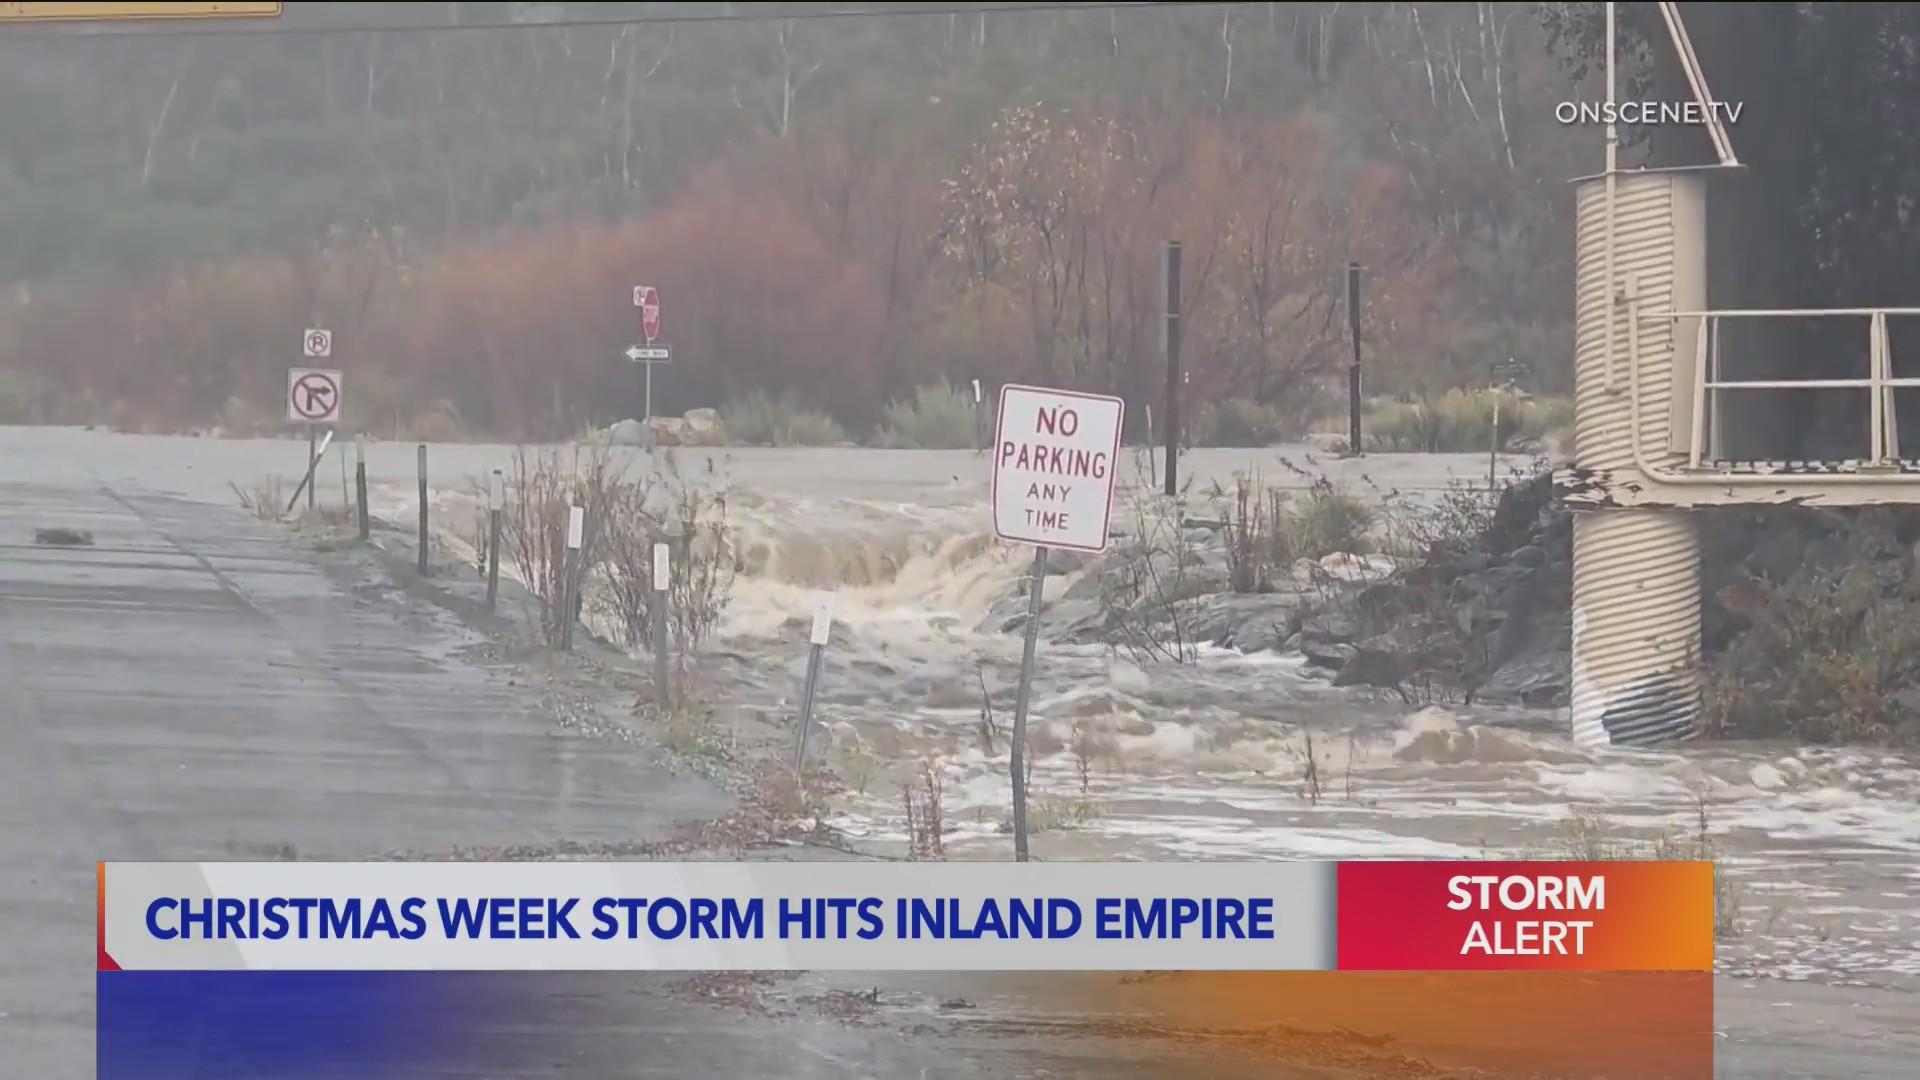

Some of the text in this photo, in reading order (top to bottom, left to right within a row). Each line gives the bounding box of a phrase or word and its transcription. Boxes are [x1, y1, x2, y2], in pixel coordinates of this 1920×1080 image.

[1037, 406, 1078, 437] NO
[1001, 441, 1106, 479] PARKING
[1027, 482, 1071, 502] ANY
[1025, 508, 1069, 530] TIME
